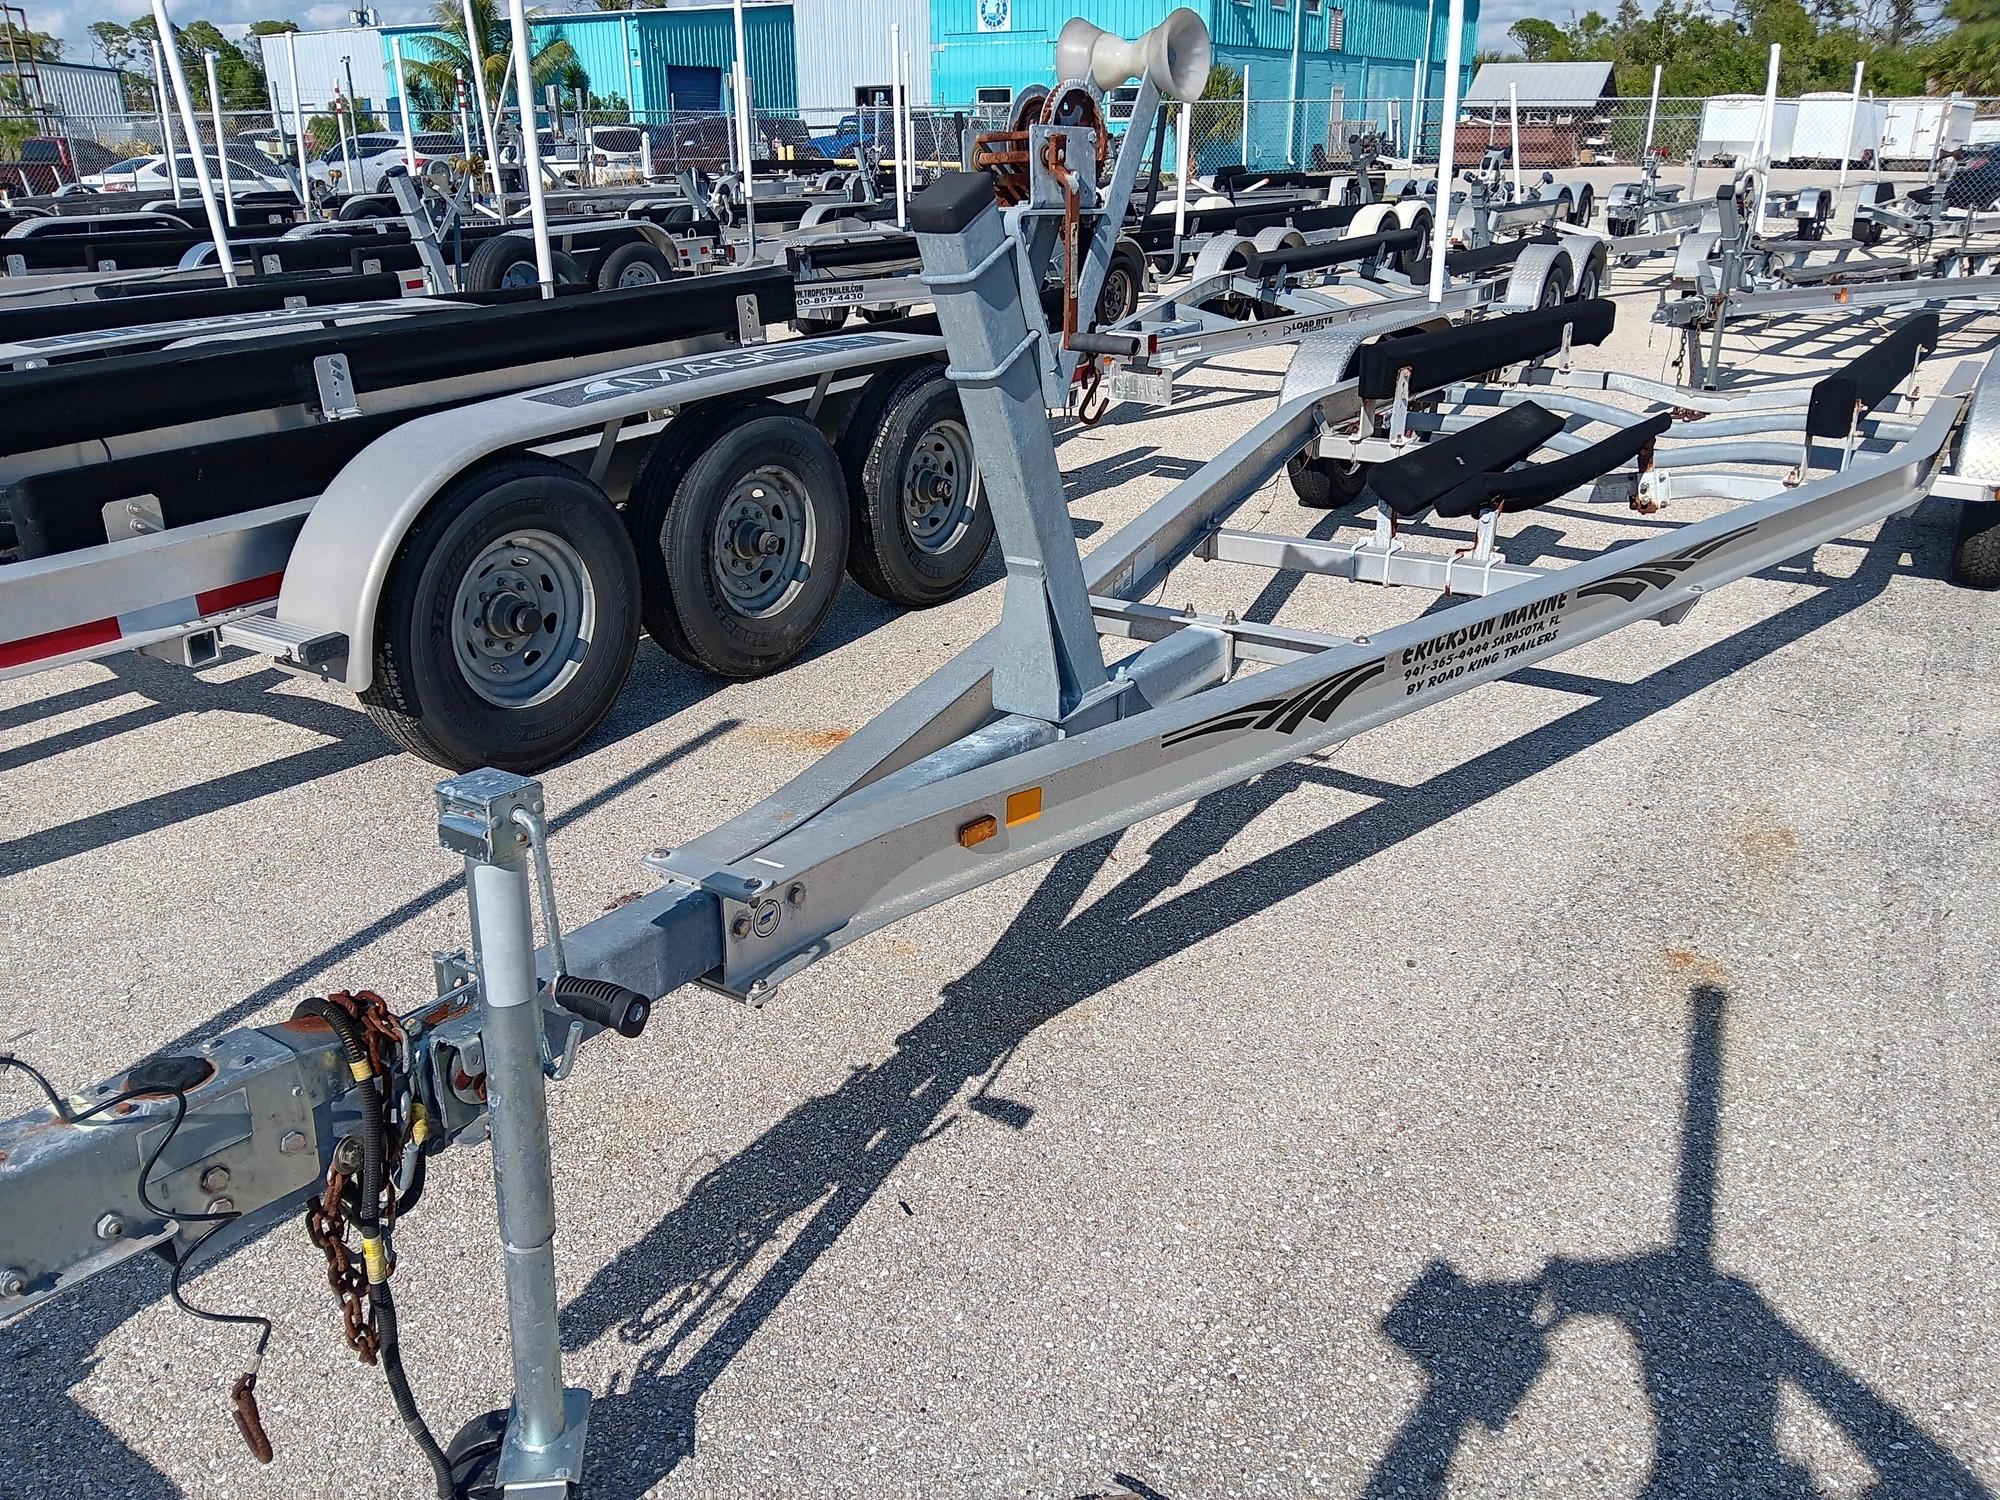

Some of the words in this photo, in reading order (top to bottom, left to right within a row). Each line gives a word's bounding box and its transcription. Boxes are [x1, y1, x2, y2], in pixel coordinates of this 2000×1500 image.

[1292, 320, 1315, 331] LOAD
[1316, 316, 1334, 327] RITE
[1500, 592, 1568, 631] MARINE
[1403, 641, 1490, 682] 941-365-4444
[1548, 614, 1561, 628] FL
[1406, 679, 1425, 696] BY
[1427, 665, 1465, 688] ROAD
[1467, 651, 1500, 673] KING
[1503, 628, 1559, 660] TRAILERS
